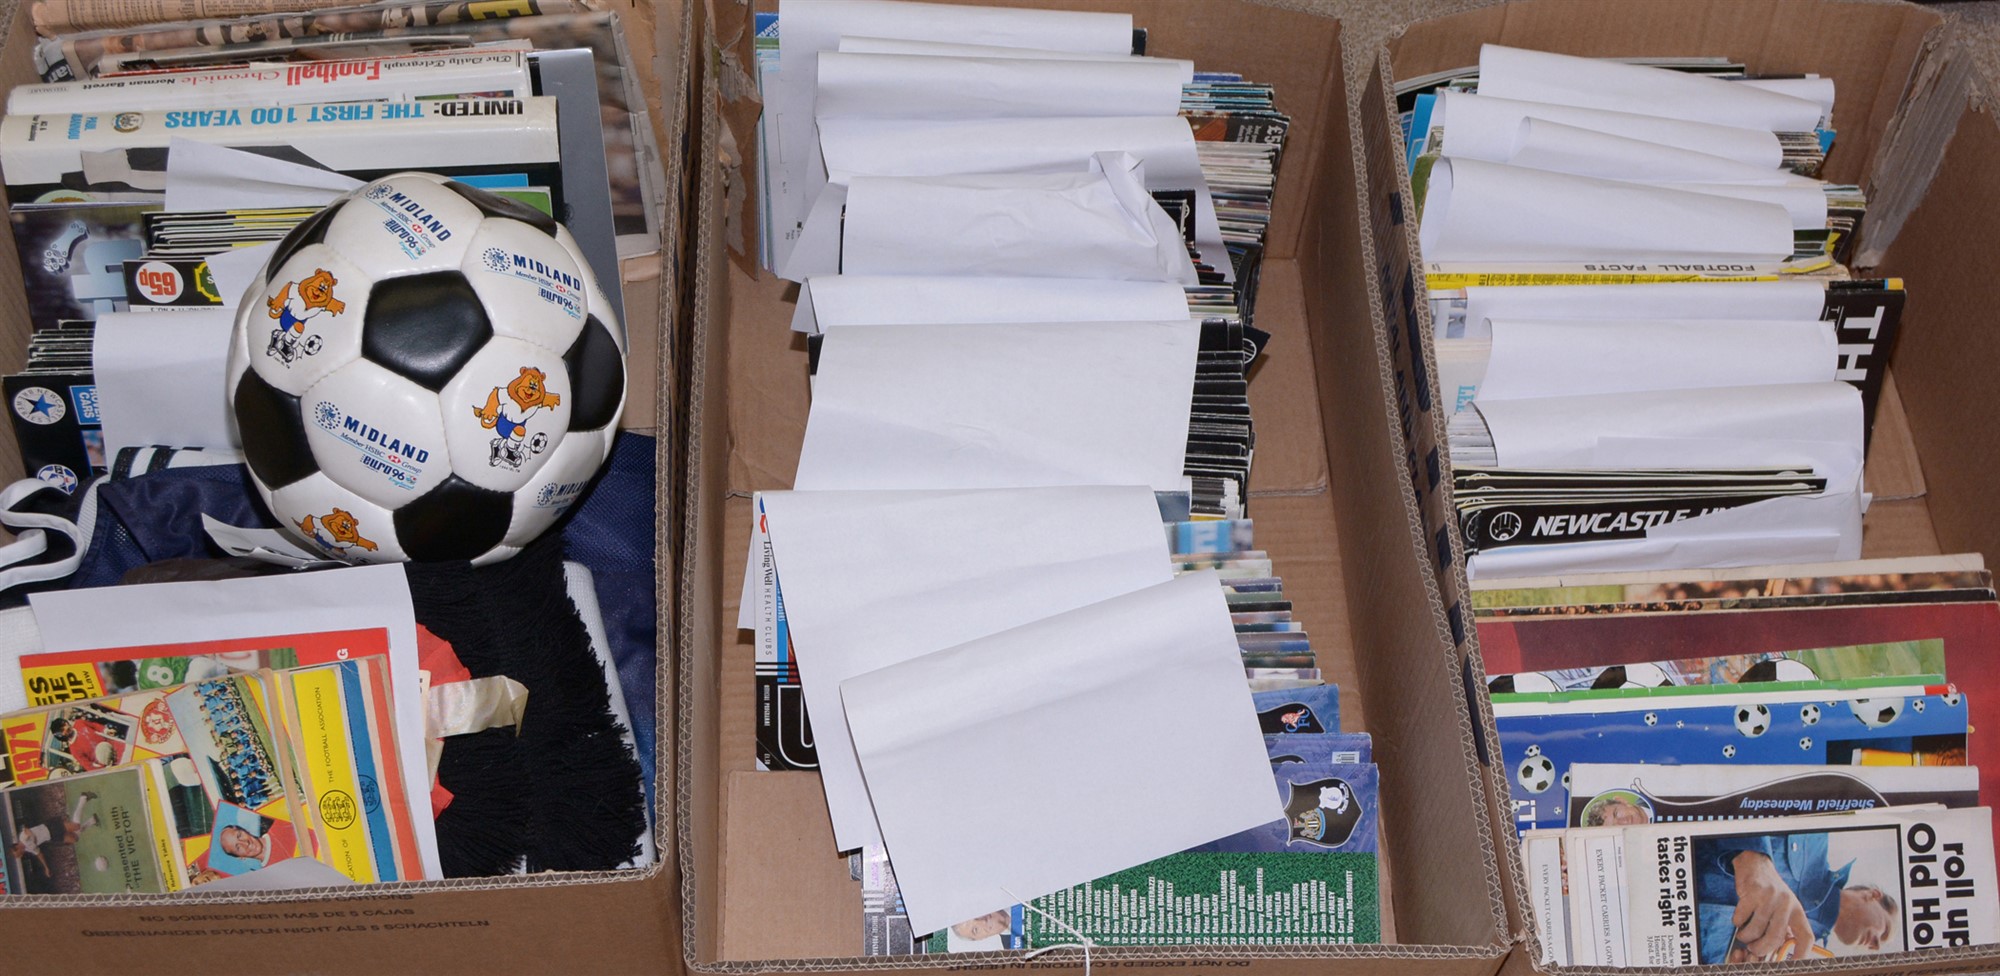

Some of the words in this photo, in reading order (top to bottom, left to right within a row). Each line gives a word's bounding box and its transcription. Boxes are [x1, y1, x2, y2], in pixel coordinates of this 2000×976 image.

[287, 61, 380, 86] Football
[384, 59, 445, 70] Telegraph
[83, 80, 125, 90] Barrett
[130, 78, 176, 86] Norman
[182, 71, 280, 86] Chronicle
[165, 109, 242, 128] YEARS
[251, 107, 298, 125] 100
[308, 105, 374, 122] FIRST
[382, 103, 425, 119] THE
[434, 100, 524, 116] UNITED:
[389, 192, 452, 242] MIDLAND
[140, 269, 176, 296] 65p
[513, 254, 580, 292] MIDLAND
[79, 392, 95, 418] CARS
[344, 416, 429, 464] MIDLAND
[365, 445, 386, 458] HSBC
[764, 588, 772, 622] HEALTH
[147, 665, 174, 686] 8
[314, 687, 326, 730] ASSOCIATION
[6, 722, 48, 780] 1971
[322, 734, 332, 767] FOOTBALL
[1740, 797, 1812, 811] Wednesday
[1816, 799, 1874, 810] Sheffield
[110, 806, 121, 830] with
[342, 840, 348, 848] OF
[1674, 836, 1688, 862] the
[1907, 823, 1938, 888] Old
[1596, 849, 1604, 872] EVERY
[1658, 837, 1672, 883] tastes
[1943, 842, 1974, 898] roll
[1542, 864, 1550, 884] EVERY
[1676, 868, 1688, 900] one
[1544, 886, 1552, 910] PACKET
[1598, 875, 1607, 903] PACKET
[363, 908, 415, 916] CAJAS
[1658, 888, 1676, 926] right
[336, 924, 367, 932] ALS
[385, 920, 490, 930] SCHACHTELN
[1545, 912, 1554, 940] CARRIES
[1602, 905, 1610, 937] CARRIES
[1678, 905, 1692, 938] that
[1942, 909, 1970, 947] up
[1190, 960, 1223, 968] NOT
[1605, 946, 1613, 966] GOVE
[1680, 943, 1692, 966] sm
